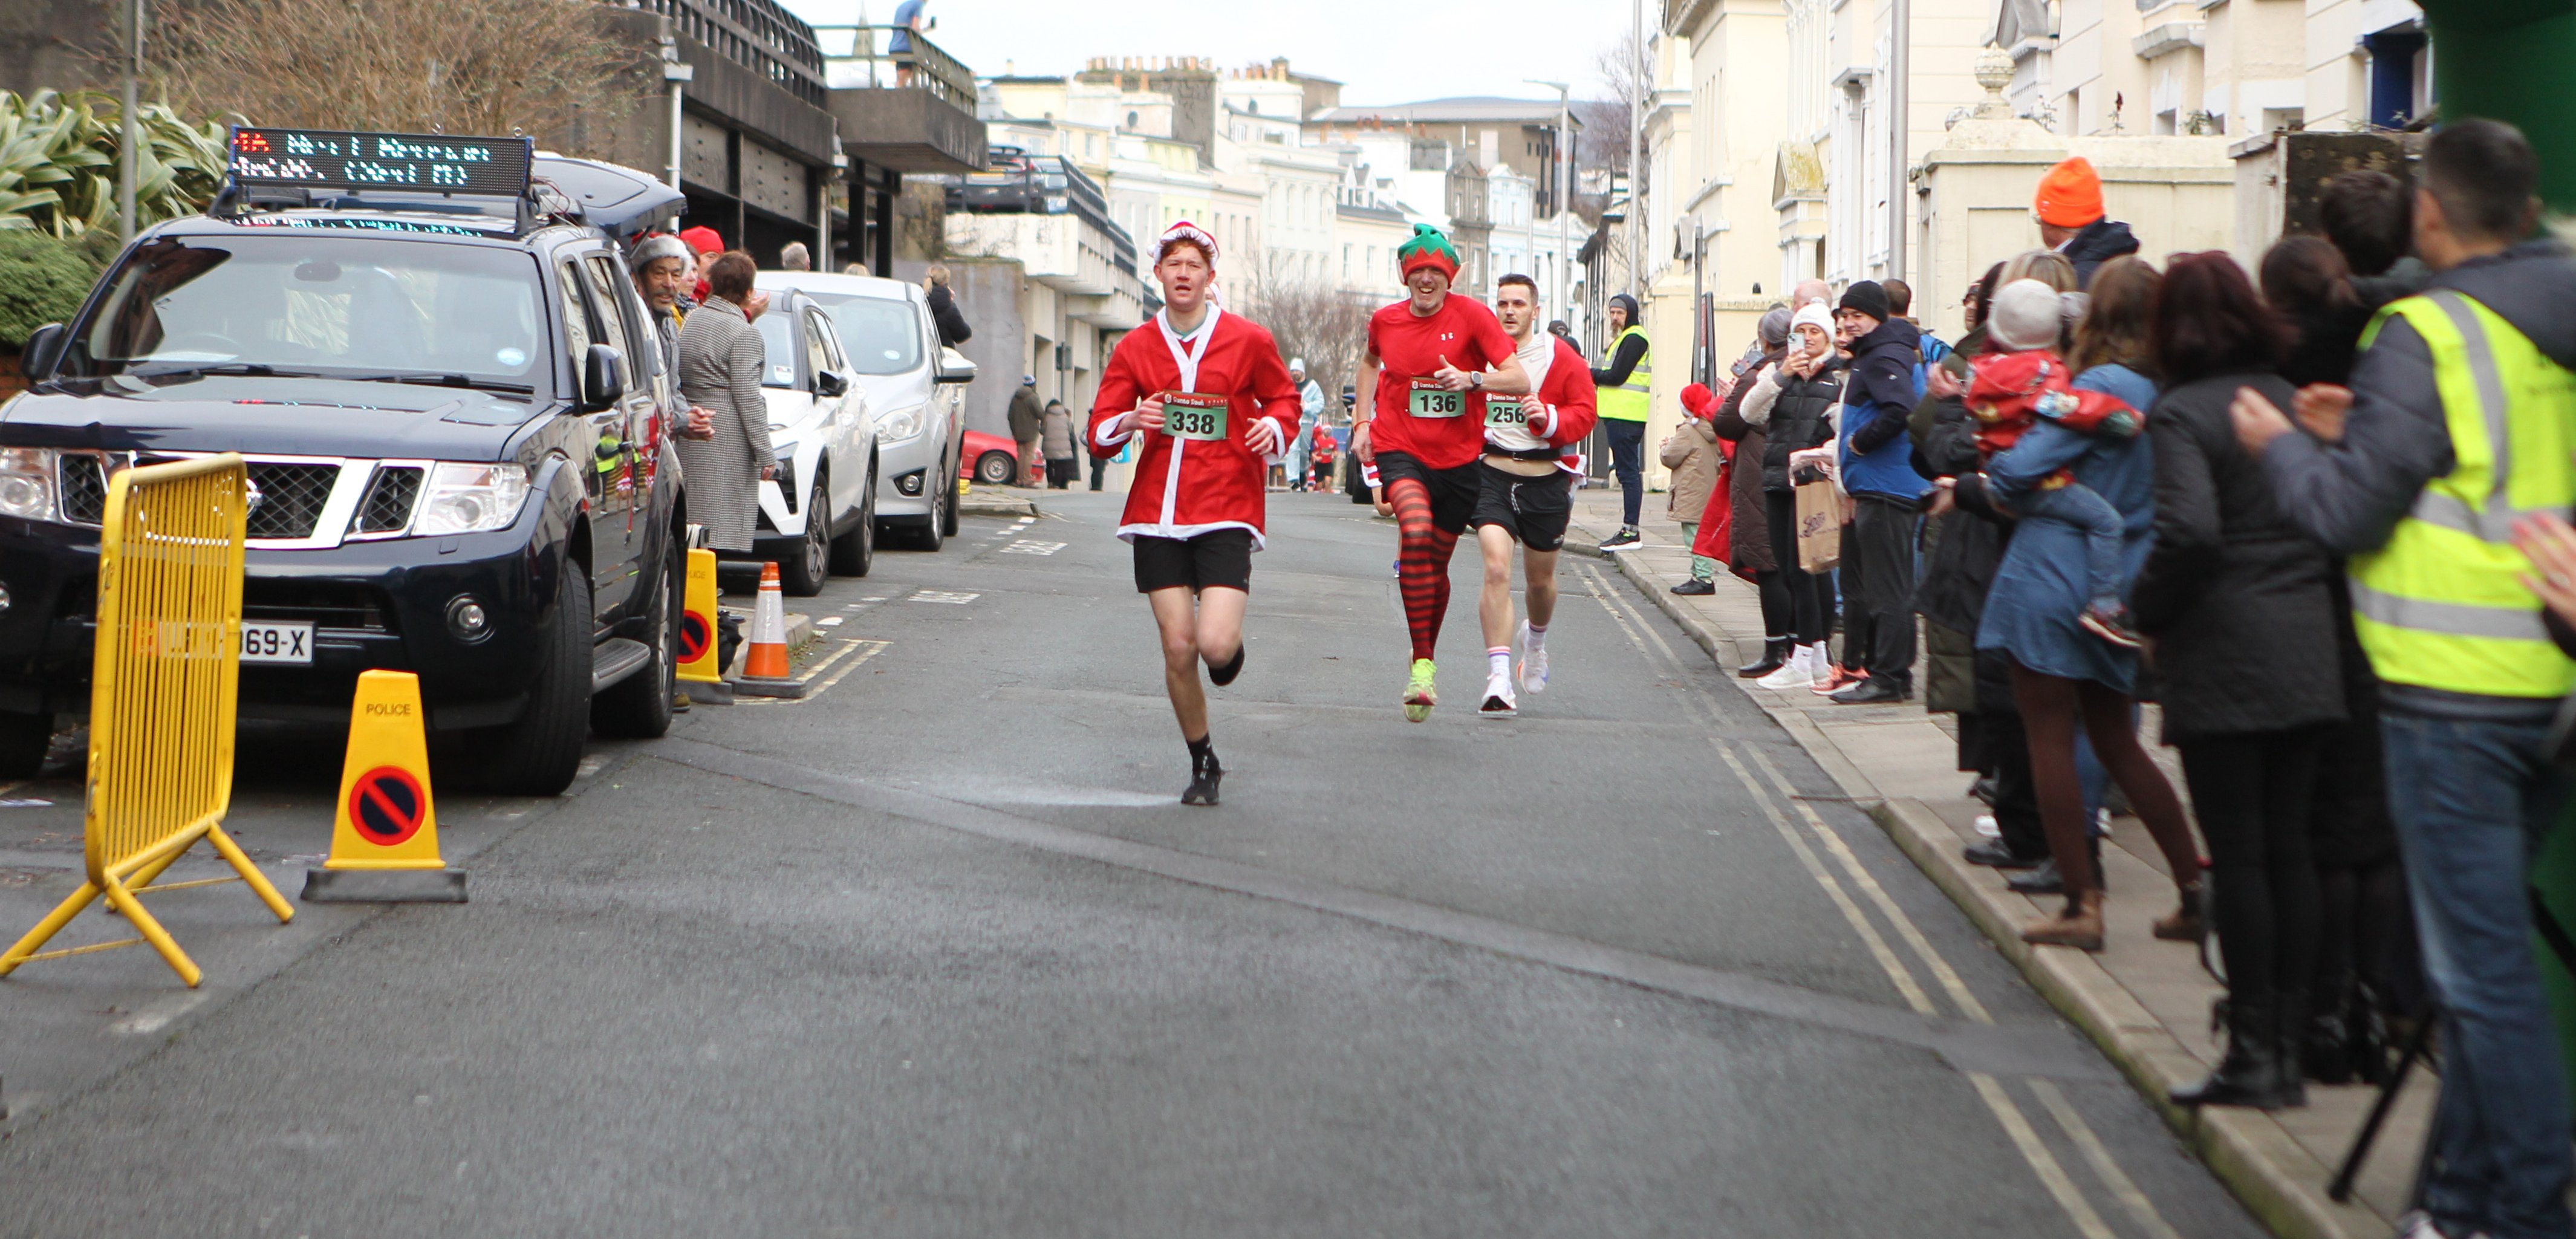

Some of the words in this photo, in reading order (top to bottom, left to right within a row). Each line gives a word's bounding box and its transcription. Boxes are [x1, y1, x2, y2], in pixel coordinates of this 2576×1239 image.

[1420, 395, 1457, 413] 136
[1171, 411, 1215, 434] 338
[1492, 406, 1526, 423] 256
[688, 570, 706, 579] LICE
[240, 629, 305, 656] 69-X
[366, 703, 411, 715] POLICE
